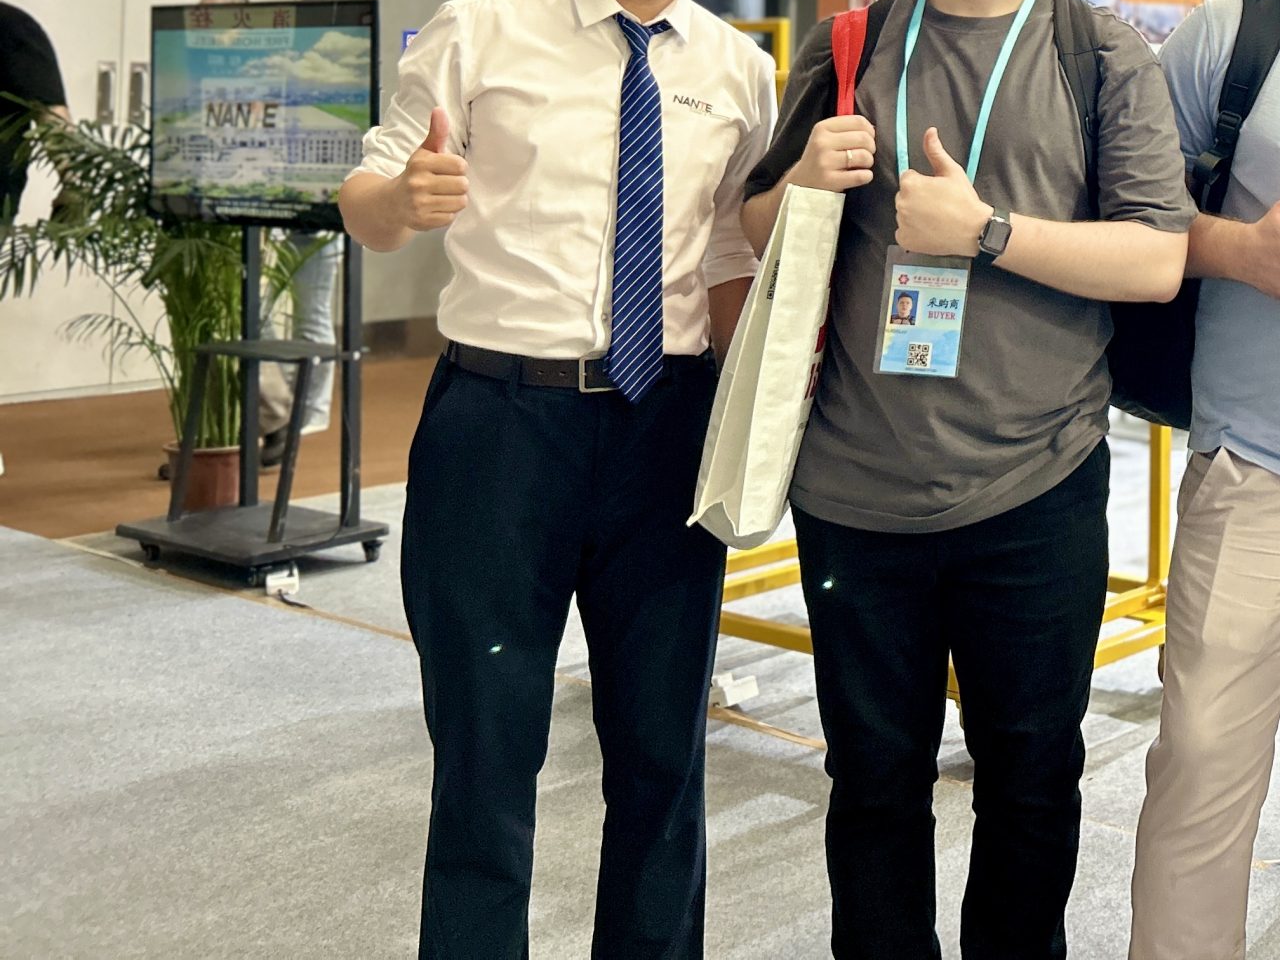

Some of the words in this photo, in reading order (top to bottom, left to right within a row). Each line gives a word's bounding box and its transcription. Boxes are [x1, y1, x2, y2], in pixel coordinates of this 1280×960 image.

[673, 94, 713, 113] NANTE
[205, 100, 281, 129] NANTE
[927, 297, 959, 310] 采购商
[928, 311, 956, 320] BUYER
